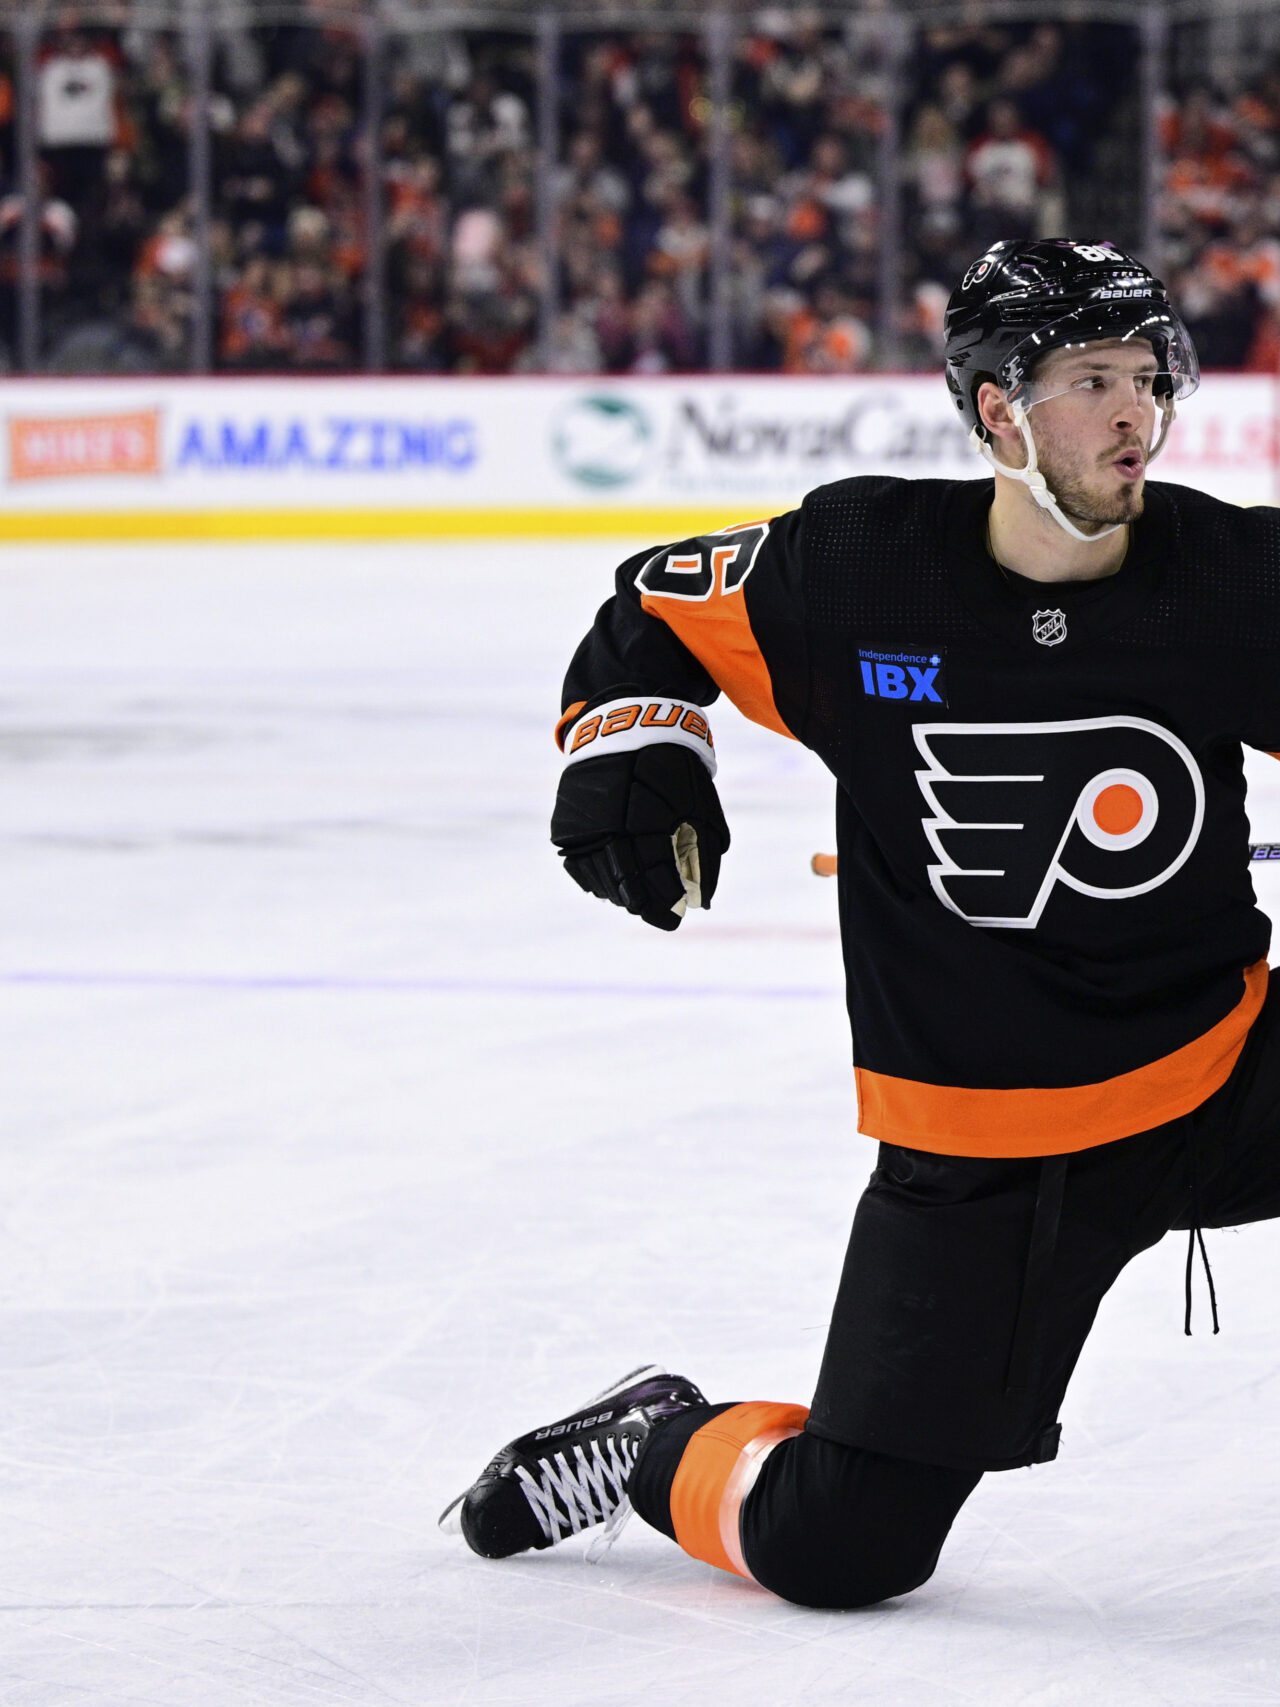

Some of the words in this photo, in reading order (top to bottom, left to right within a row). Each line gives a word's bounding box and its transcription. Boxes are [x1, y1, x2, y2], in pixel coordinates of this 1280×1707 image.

[1073, 245, 1124, 262] 86
[1100, 288, 1153, 299] BAUER
[176, 414, 478, 473] AMAZING
[858, 648, 928, 664] Independence
[860, 660, 943, 703] IBX
[535, 1410, 613, 1441] BAUER
